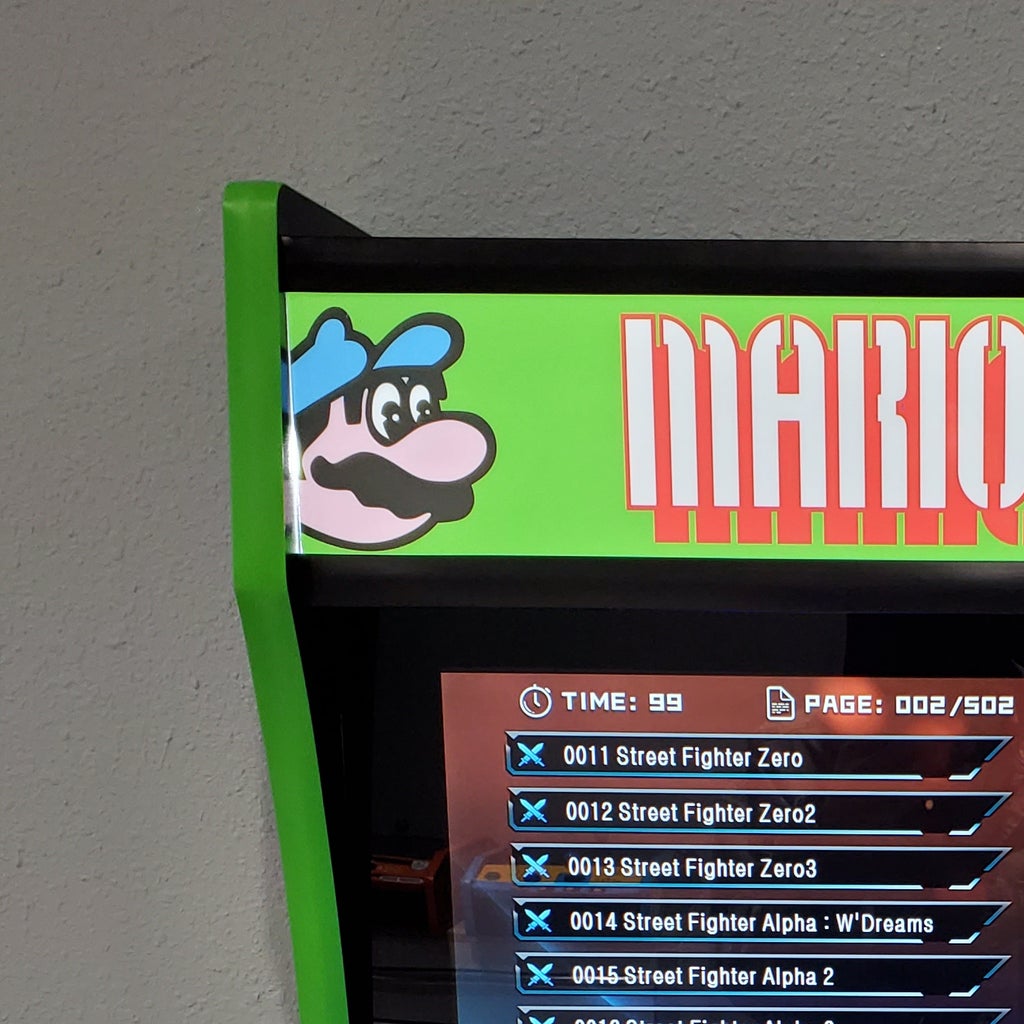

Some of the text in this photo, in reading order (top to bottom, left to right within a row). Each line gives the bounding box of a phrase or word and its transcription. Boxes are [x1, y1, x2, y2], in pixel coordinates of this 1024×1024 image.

[562, 691, 683, 712] TIME: 99
[804, 694, 883, 716] PAGE:
[563, 746, 803, 771] 0011 Street Fighter Zero
[565, 801, 817, 827] 0012 Street Fighter Zero2
[567, 856, 818, 882] 0013 Street Fighter Zero3
[570, 911, 618, 932] 0014
[623, 911, 683, 933] Street
[687, 912, 757, 937] Fighter
[762, 913, 818, 938] Alpha
[836, 913, 934, 934] W'Dreams
[571, 965, 835, 990] 0015 Street Fighter Alpha 2
